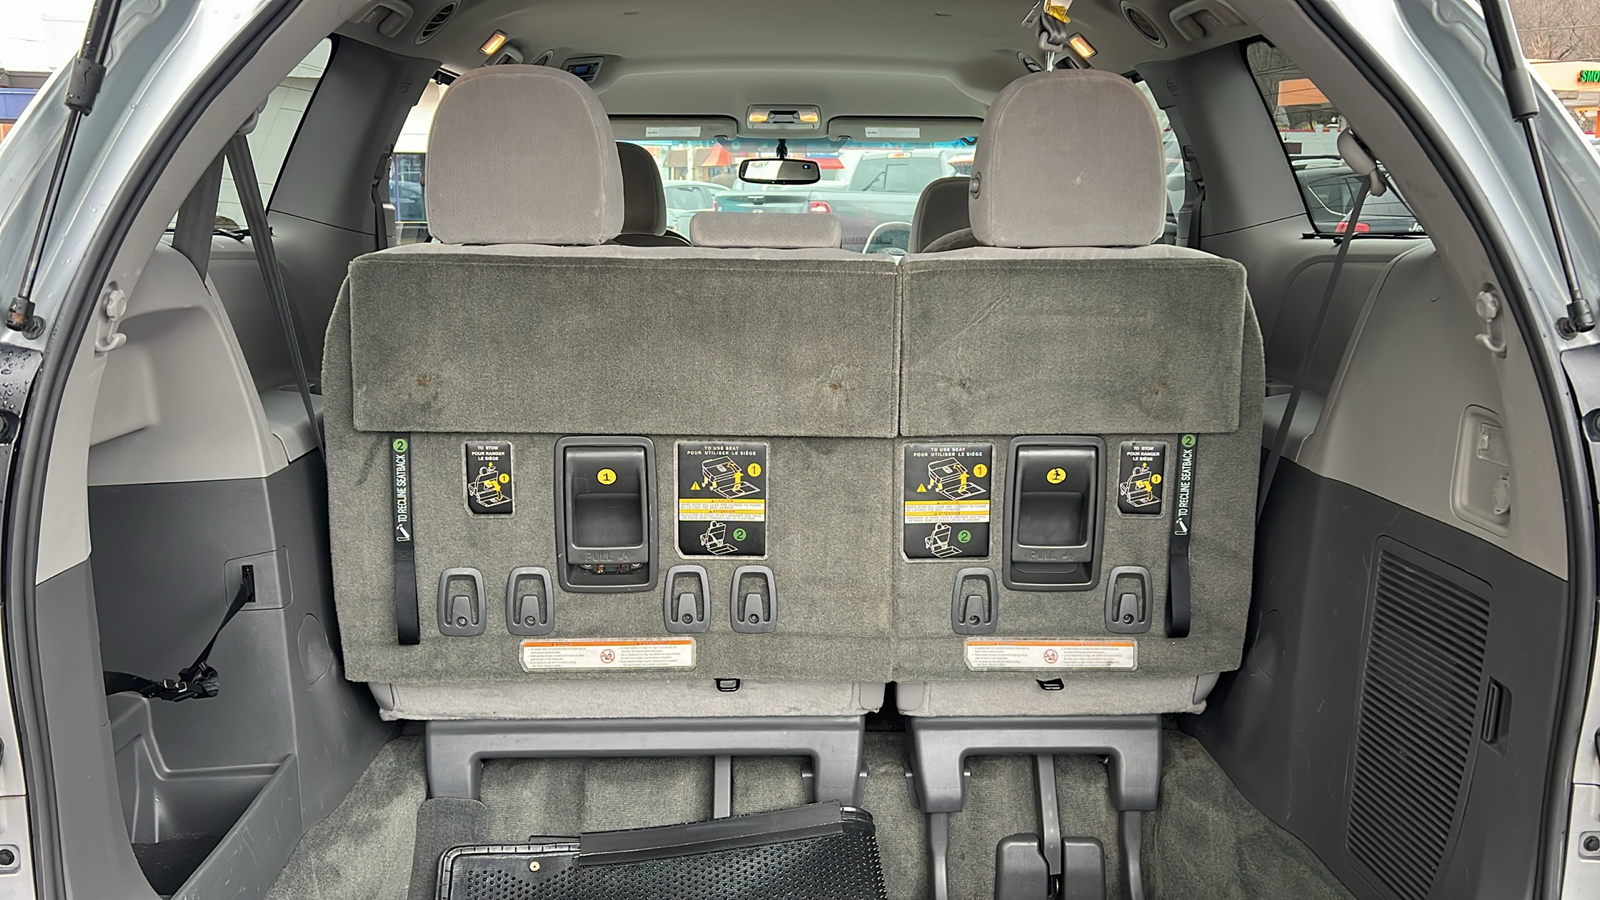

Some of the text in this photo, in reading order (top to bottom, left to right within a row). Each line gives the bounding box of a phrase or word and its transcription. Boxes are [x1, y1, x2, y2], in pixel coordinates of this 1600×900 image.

[396, 454, 408, 523] TO RECLINE SEATBACK
[1178, 449, 1192, 516] TO RECLINE SEATBACK
[585, 552, 613, 562] PULL
